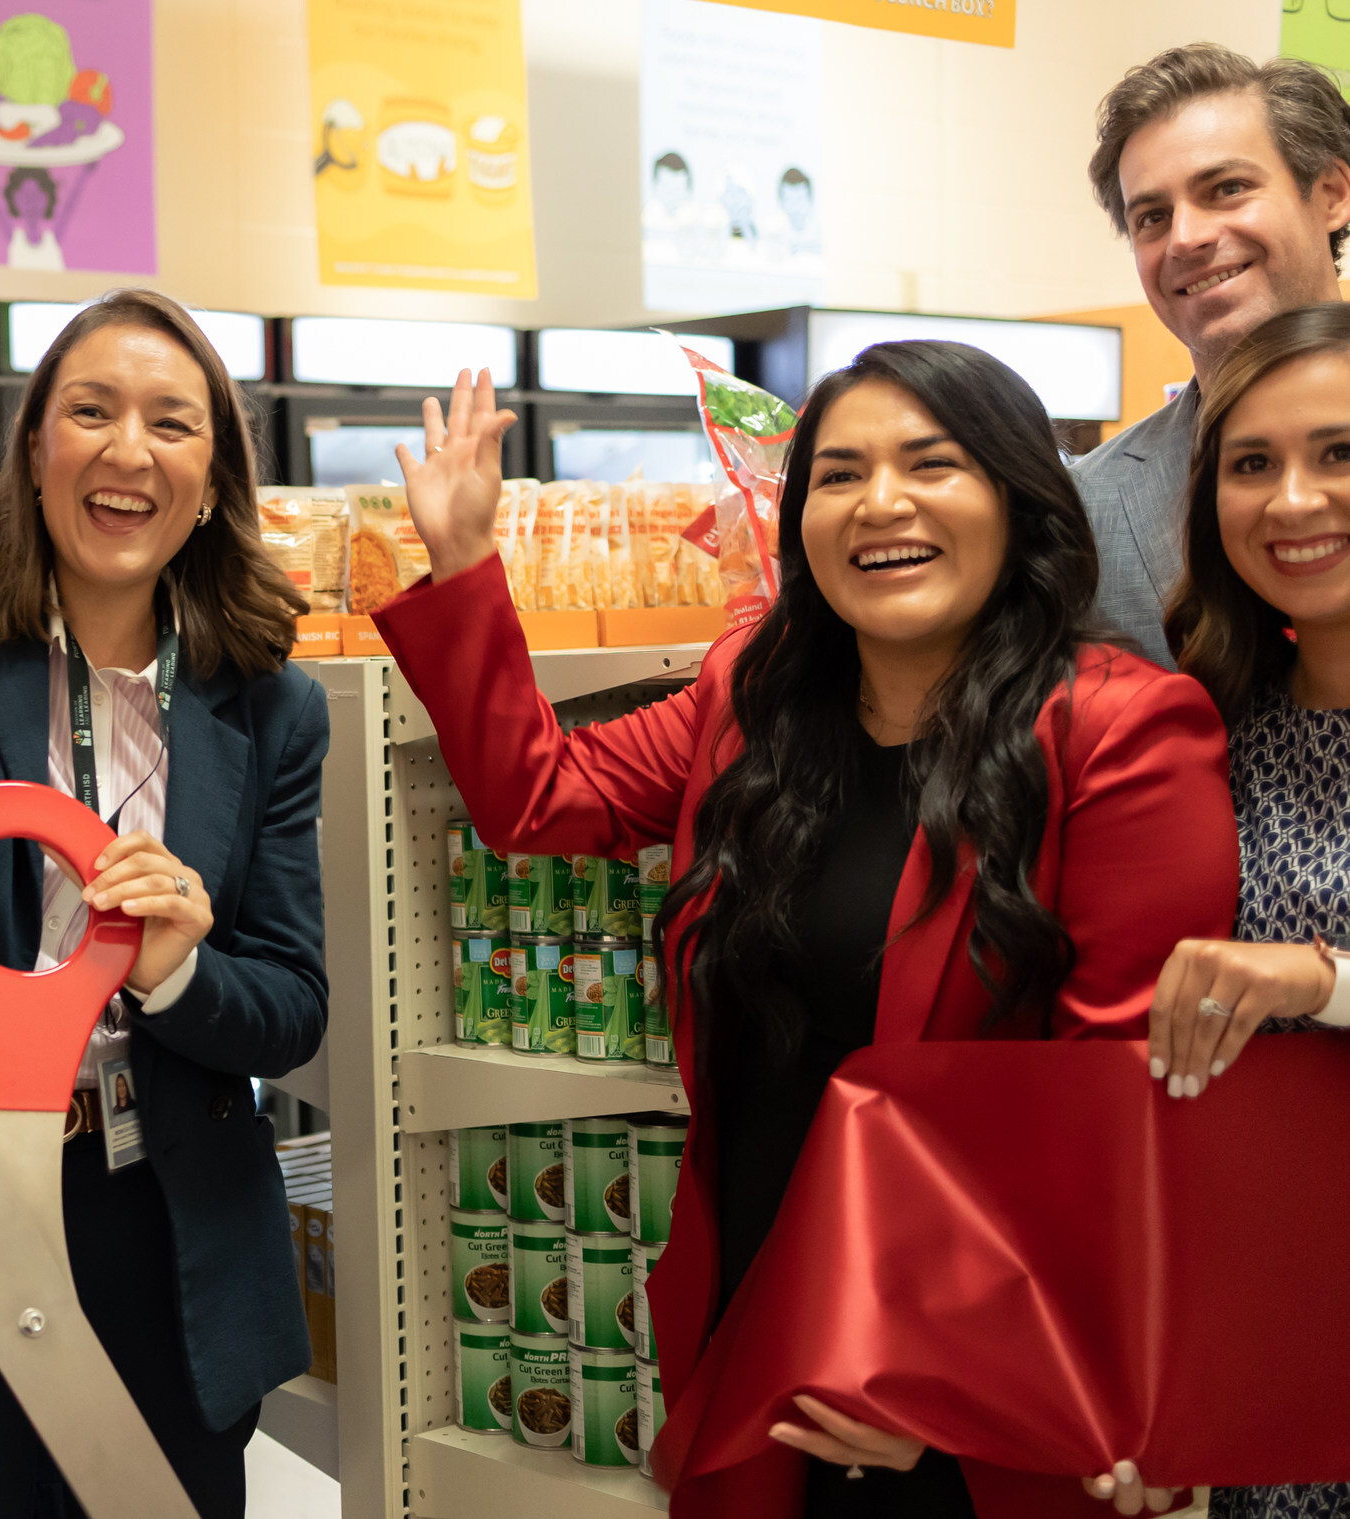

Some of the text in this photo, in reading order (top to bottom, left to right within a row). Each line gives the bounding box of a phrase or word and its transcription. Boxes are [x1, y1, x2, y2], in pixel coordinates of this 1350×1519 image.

[296, 631, 340, 642] ANISH RIC
[358, 632, 381, 641] SPAN
[84, 789, 92, 808] RTH
[494, 957, 507, 967] Del
[563, 964, 574, 974] De
[539, 1141, 556, 1150] Cut
[608, 1151, 624, 1160] Cut
[468, 1242, 507, 1251] Cut Gree
[545, 1254, 562, 1263] Cut
[620, 1266, 632, 1275] Cu
[492, 1352, 508, 1361] Cut
[519, 1364, 532, 1374] Cut
[534, 1367, 563, 1376] Green
[619, 1384, 635, 1393] Cut
